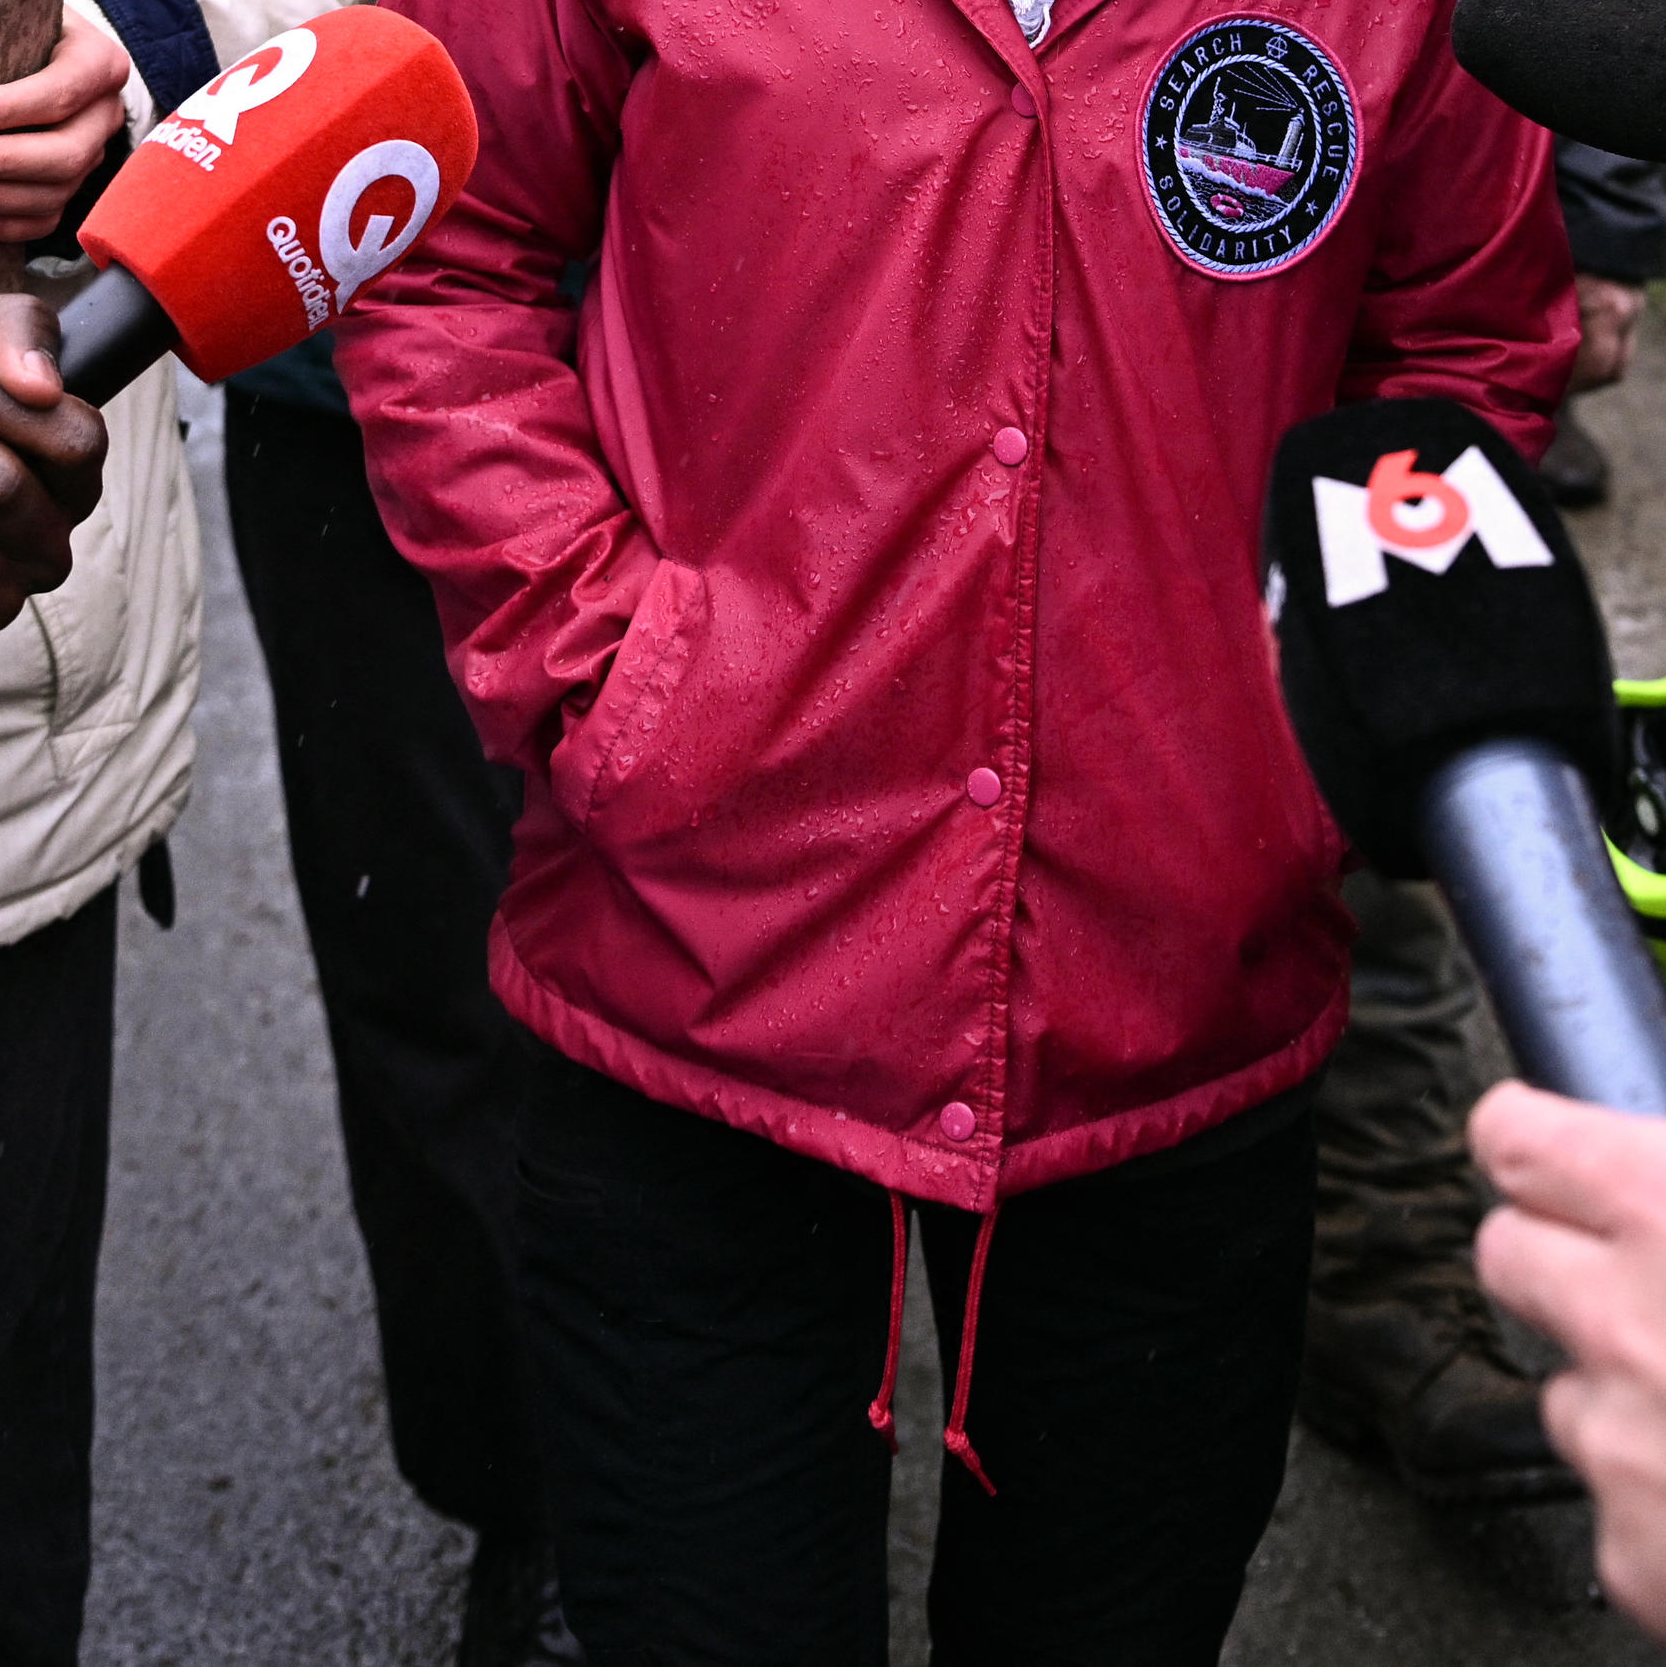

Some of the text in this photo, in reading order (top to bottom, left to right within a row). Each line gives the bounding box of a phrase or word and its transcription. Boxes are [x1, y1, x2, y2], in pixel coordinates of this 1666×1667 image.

[1159, 33, 1344, 183] SEARCH RESCUE
[319, 139, 440, 315] Q
[1159, 175, 1293, 260] SOLIDARITY
